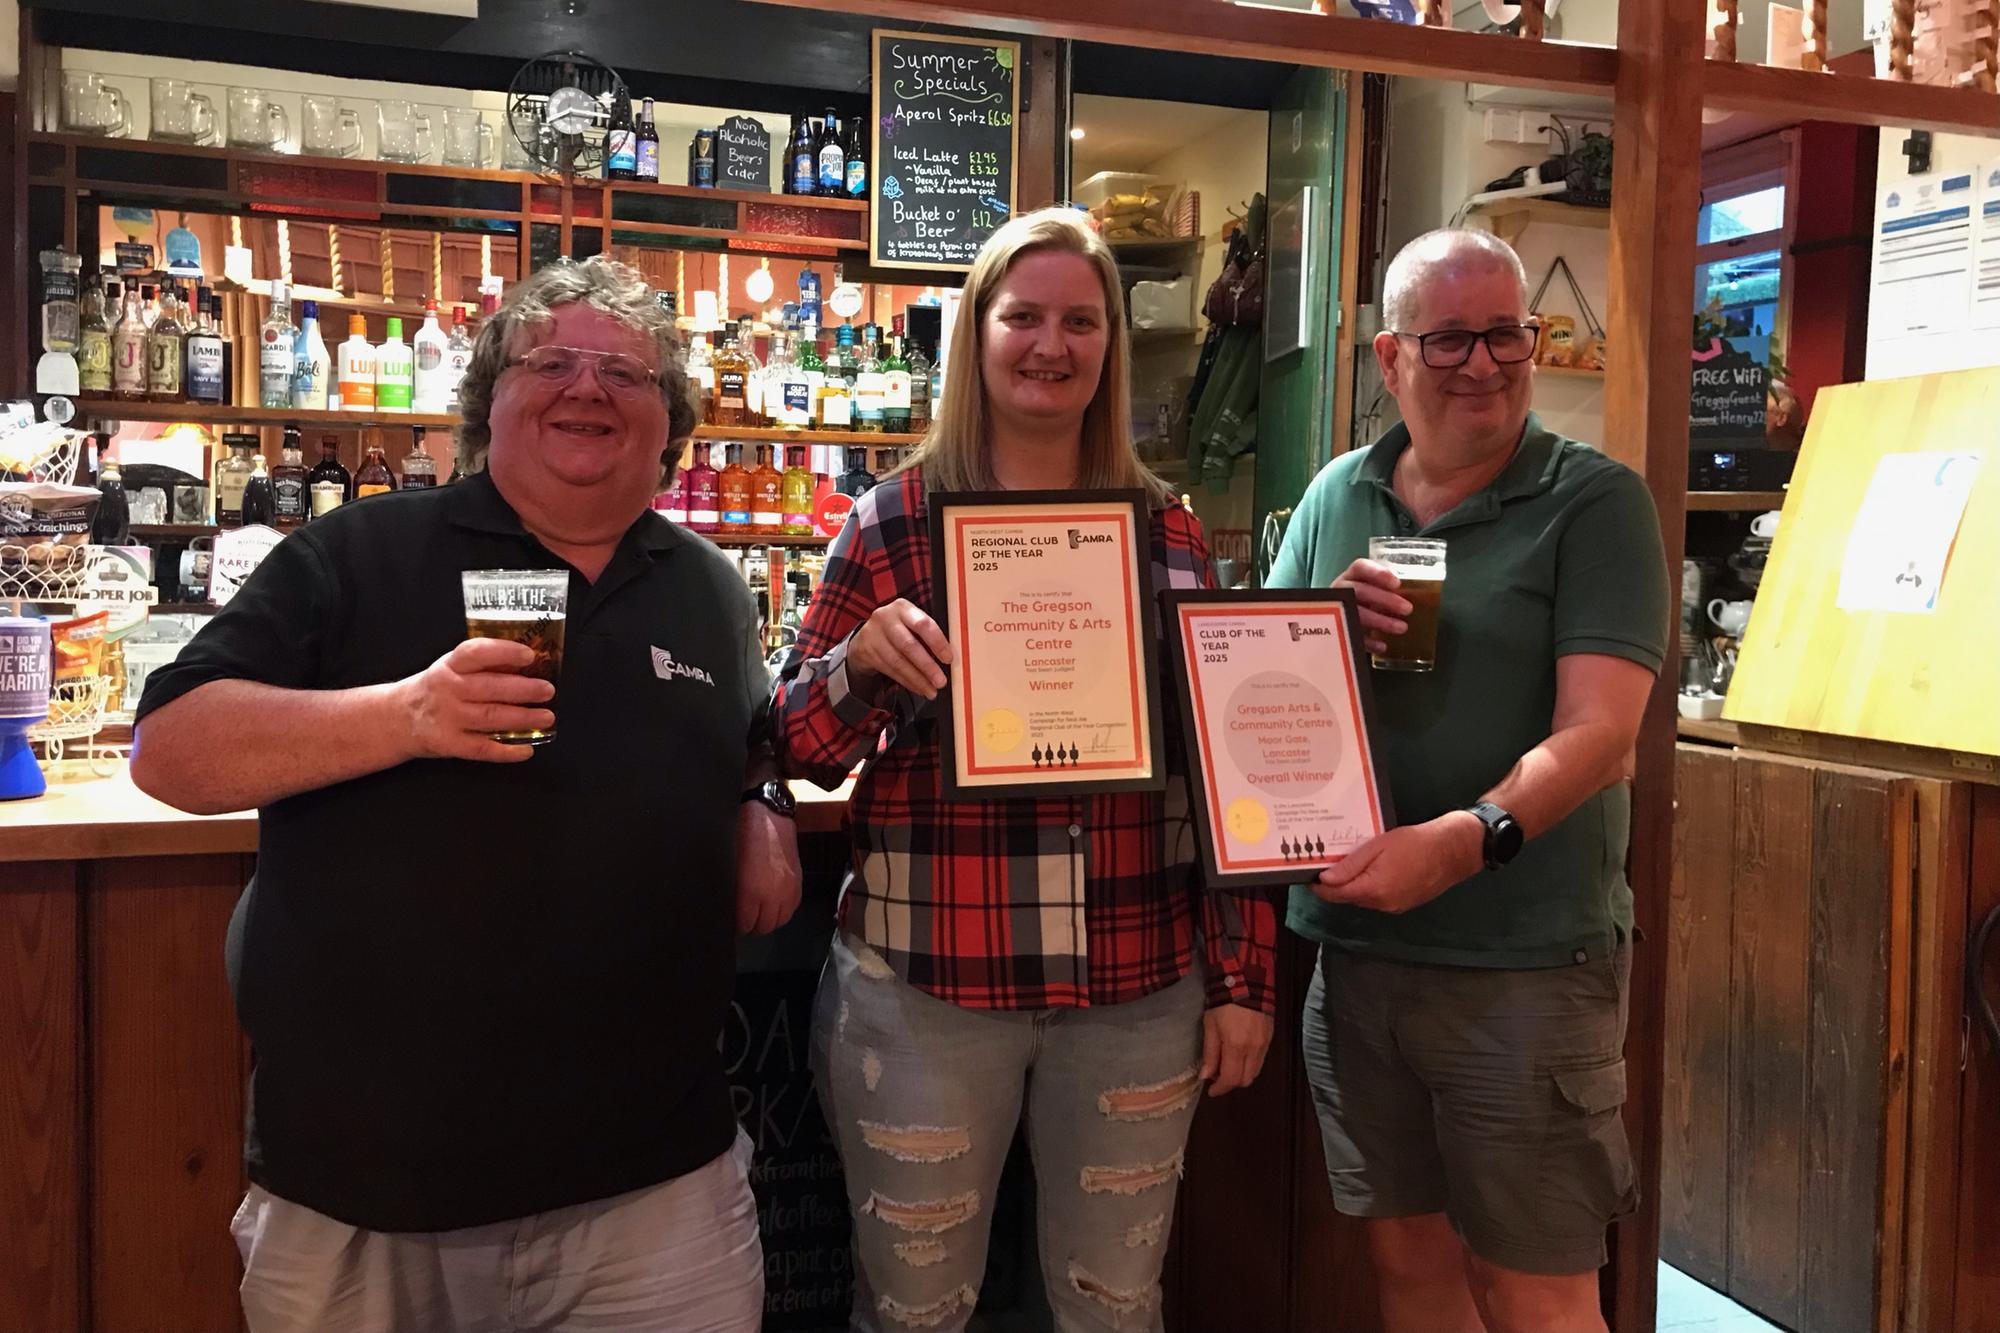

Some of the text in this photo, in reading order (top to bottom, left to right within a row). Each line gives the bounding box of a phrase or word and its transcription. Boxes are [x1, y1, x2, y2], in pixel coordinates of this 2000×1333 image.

[892, 45, 979, 74] Summer
[914, 71, 988, 96] Specials
[894, 104, 941, 126] Aperol
[949, 108, 986, 127] Spritz
[735, 119, 757, 133] Non
[720, 129, 768, 151] Alcoholic
[729, 147, 763, 165] Beers
[894, 145, 918, 160] Iced
[924, 148, 959, 165] Latte
[727, 166, 759, 180] Cider
[893, 200, 940, 223] Bucket
[972, 209, 994, 228] £12
[916, 222, 956, 238] Beer
[898, 241, 925, 249] bottles
[927, 243, 937, 251] of
[721, 374, 743, 382] JURA
[1692, 368, 1730, 386] FREE
[824, 512, 848, 520] Estrell
[972, 537, 1058, 547] REGIONAL CLUB
[1075, 535, 1114, 543] CAMRA
[972, 549, 1043, 559] OF THE YEAR
[219, 558, 249, 570] RARE
[973, 562, 998, 571] 2025
[129, 590, 153, 603] JOB
[522, 588, 546, 606] THE
[1001, 601, 1092, 613] The Gregson
[984, 618, 1112, 632] Community & Arts
[1200, 629, 1265, 638] CLUB OF THE
[1296, 627, 1331, 636] CAMRA
[1025, 638, 1073, 650] Centre
[1201, 642, 1229, 650] YEAR
[38, 654, 46, 672] A
[1025, 657, 1076, 667] Lancaster
[1204, 654, 1228, 662] 2025
[664, 660, 715, 687] CAMRA
[1029, 680, 1074, 691] Winner
[1237, 704, 1285, 715] Gregson
[1288, 703, 1311, 713] Arts
[1230, 718, 1333, 731] Community Centre
[1258, 736, 1282, 744] Moor
[1262, 749, 1310, 758] Lancaster
[1247, 771, 1334, 784] Overall Winner
